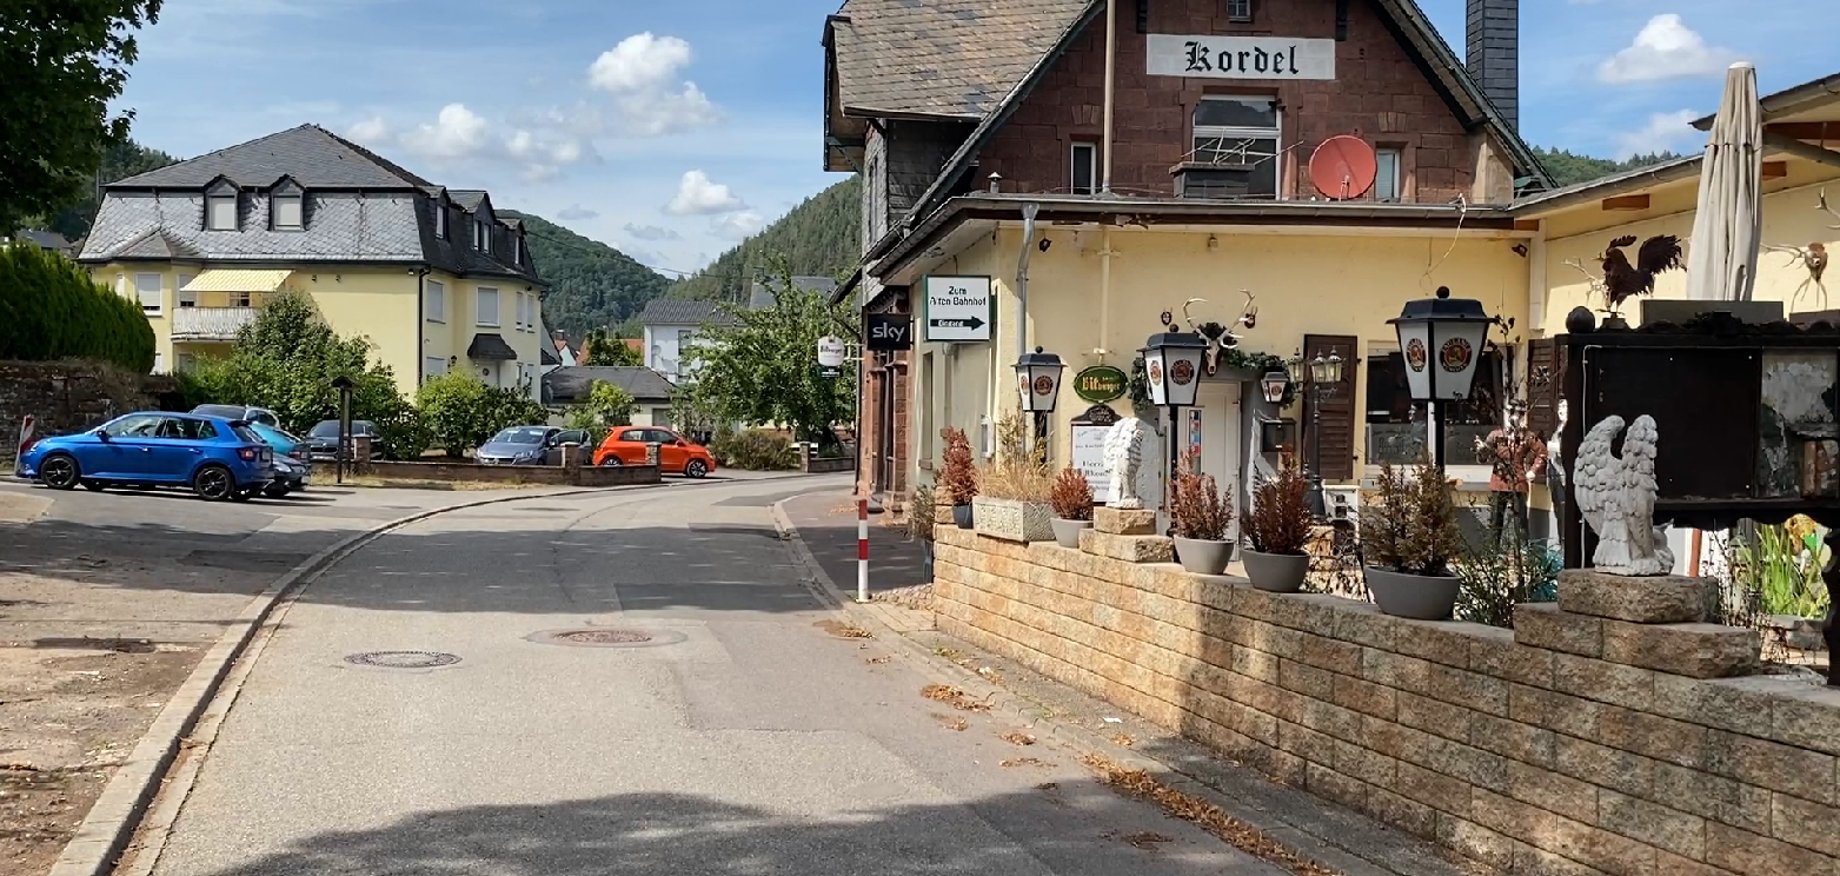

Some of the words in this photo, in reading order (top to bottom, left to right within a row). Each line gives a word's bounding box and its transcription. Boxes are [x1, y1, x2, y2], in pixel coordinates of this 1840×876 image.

[1184, 40, 1299, 75] Kordel
[948, 285, 967, 295] Zum
[930, 296, 950, 306] Aten
[953, 296, 986, 306] Bahnhof
[872, 322, 905, 342] sky
